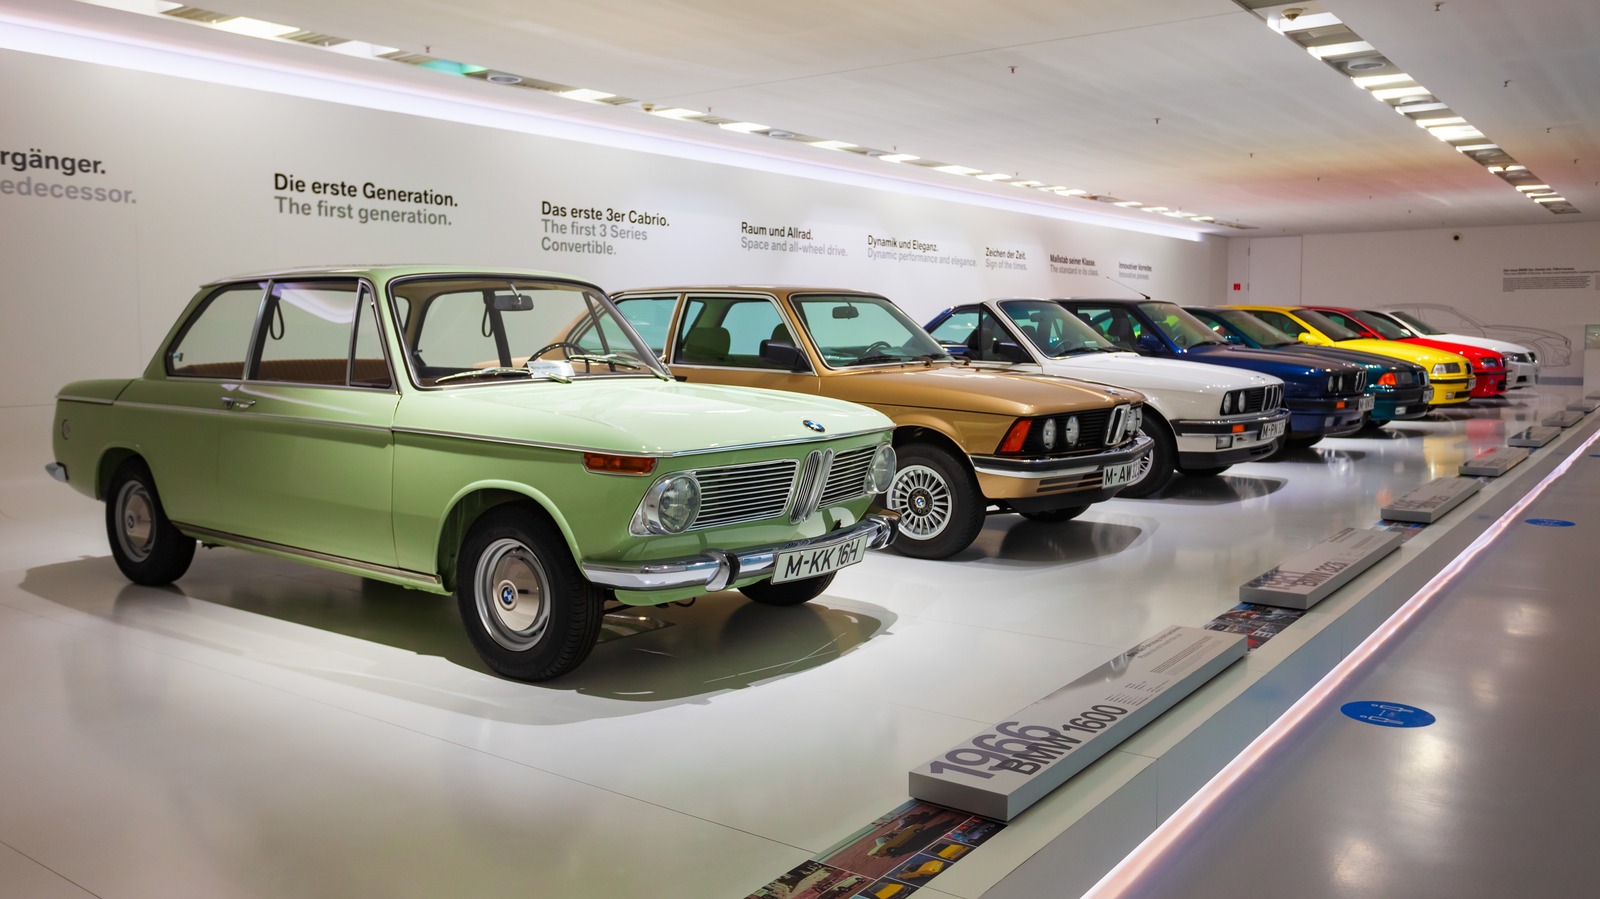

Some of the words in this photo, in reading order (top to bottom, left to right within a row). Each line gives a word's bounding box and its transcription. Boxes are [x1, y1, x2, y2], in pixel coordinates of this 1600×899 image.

[0, 148, 106, 176] rgänger.
[0, 176, 137, 204] edecessor.
[274, 172, 306, 193] Die
[311, 180, 358, 198] erste
[362, 182, 458, 207] Generation.
[274, 196, 312, 216] The
[317, 200, 354, 219] first
[358, 207, 452, 226] generation.
[541, 200, 567, 217] Das
[570, 207, 603, 221] erste
[606, 208, 626, 222] 3er
[628, 210, 670, 227] Cabrio.
[541, 218, 568, 235] The
[571, 221, 596, 237] first
[599, 224, 607, 237] 3
[610, 224, 648, 241] Series
[741, 221, 767, 235] Raum
[769, 226, 785, 237] und
[787, 226, 813, 240] Allrad.
[541, 236, 617, 255] Convertible.
[741, 236, 769, 251] Space
[771, 241, 787, 252] and
[789, 241, 826, 255] all-wheel
[827, 245, 848, 257] drive.
[867, 234, 898, 248] Dynamik
[898, 239, 911, 250] und
[912, 240, 938, 253] Eleganz.
[985, 247, 1006, 258] Zeichen
[1006, 250, 1015, 259] der
[867, 247, 897, 260] Dynamic
[898, 252, 938, 264] performance
[939, 255, 950, 265] and
[951, 256, 978, 268] elegance.
[998, 260, 1004, 269] of
[1004, 260, 1012, 270] the
[784, 547, 836, 578] M-KK
[836, 538, 860, 567] 16H
[930, 721, 1061, 780] 1966
[995, 731, 1082, 776] BMW
[1062, 704, 1128, 734] 1600
